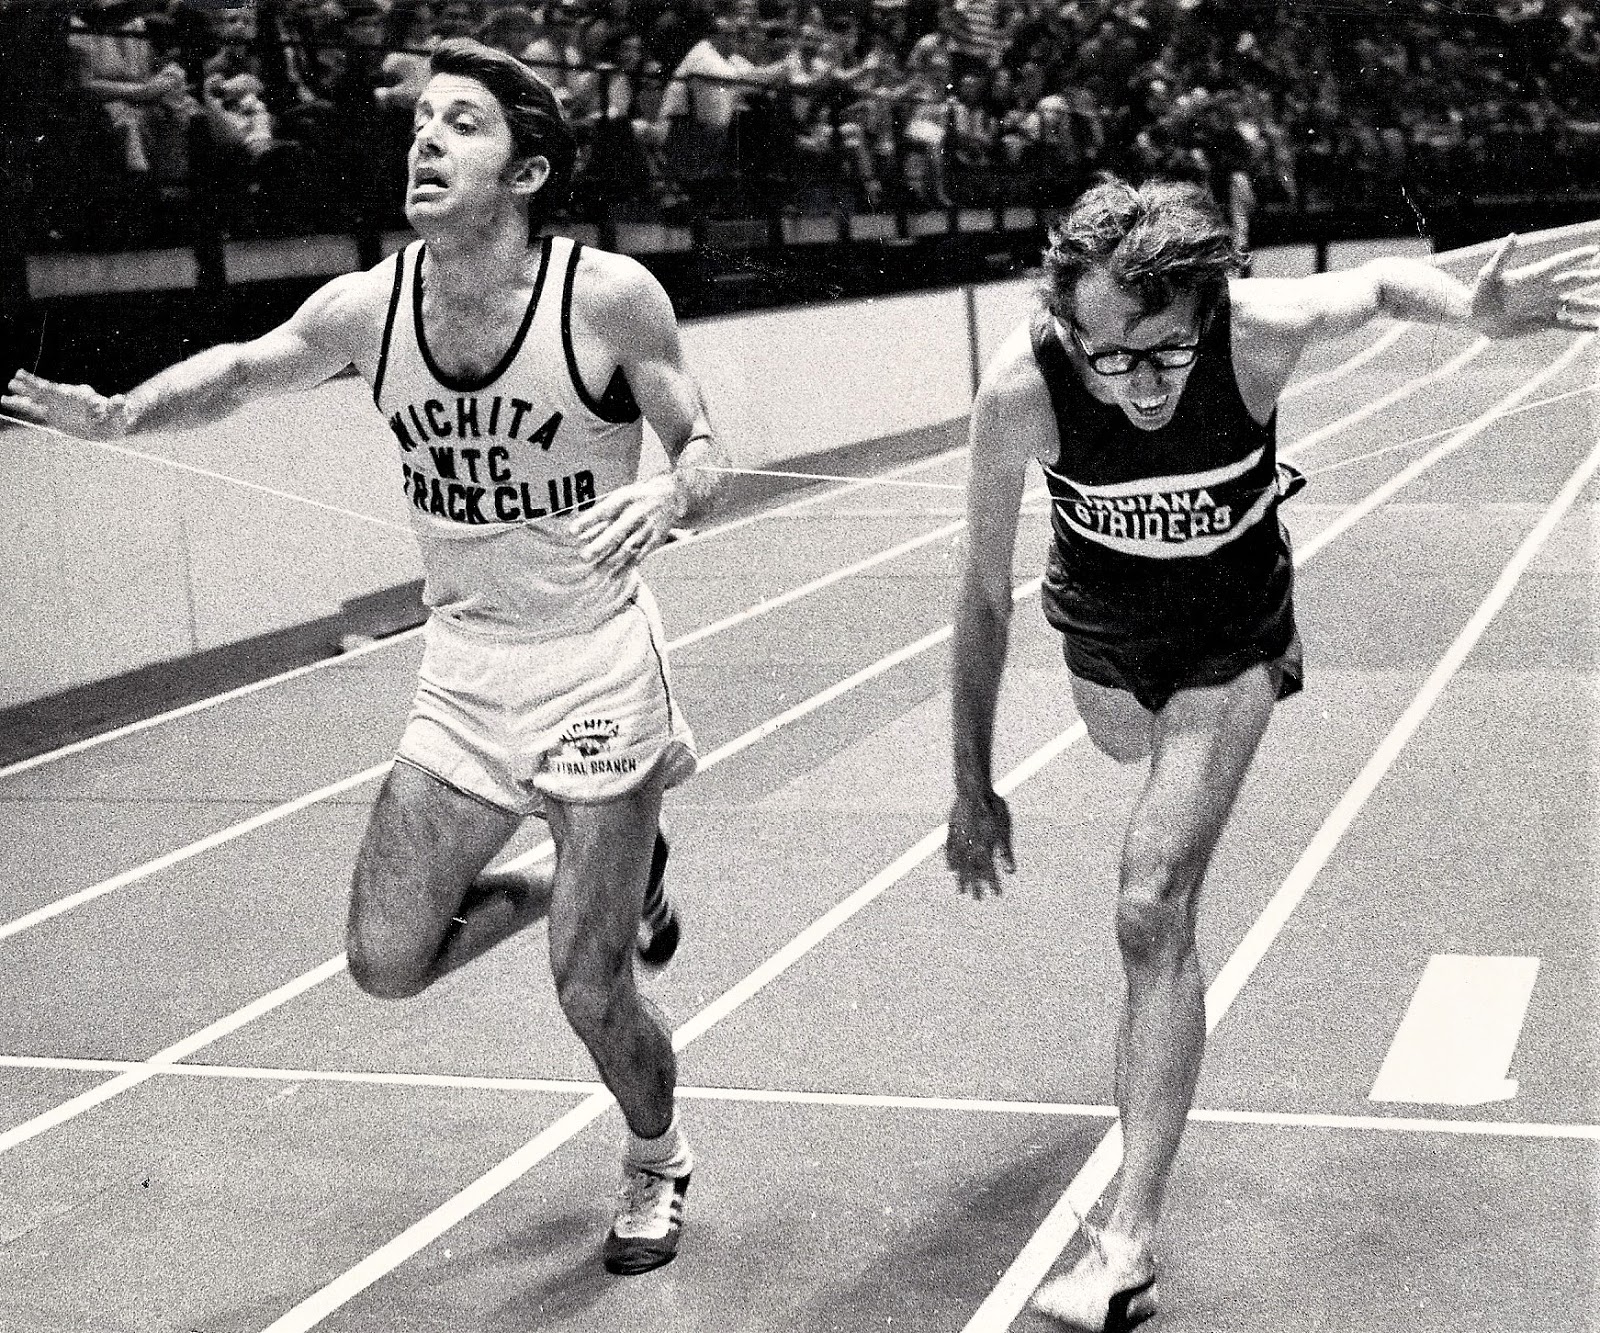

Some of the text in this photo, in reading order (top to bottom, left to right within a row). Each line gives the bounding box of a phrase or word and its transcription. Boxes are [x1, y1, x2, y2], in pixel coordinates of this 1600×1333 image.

[429, 446, 512, 484] WTC
[494, 469, 597, 521] CLUB
[1075, 502, 1232, 540] STRIDERS
[590, 758, 637, 775] BRANCH
